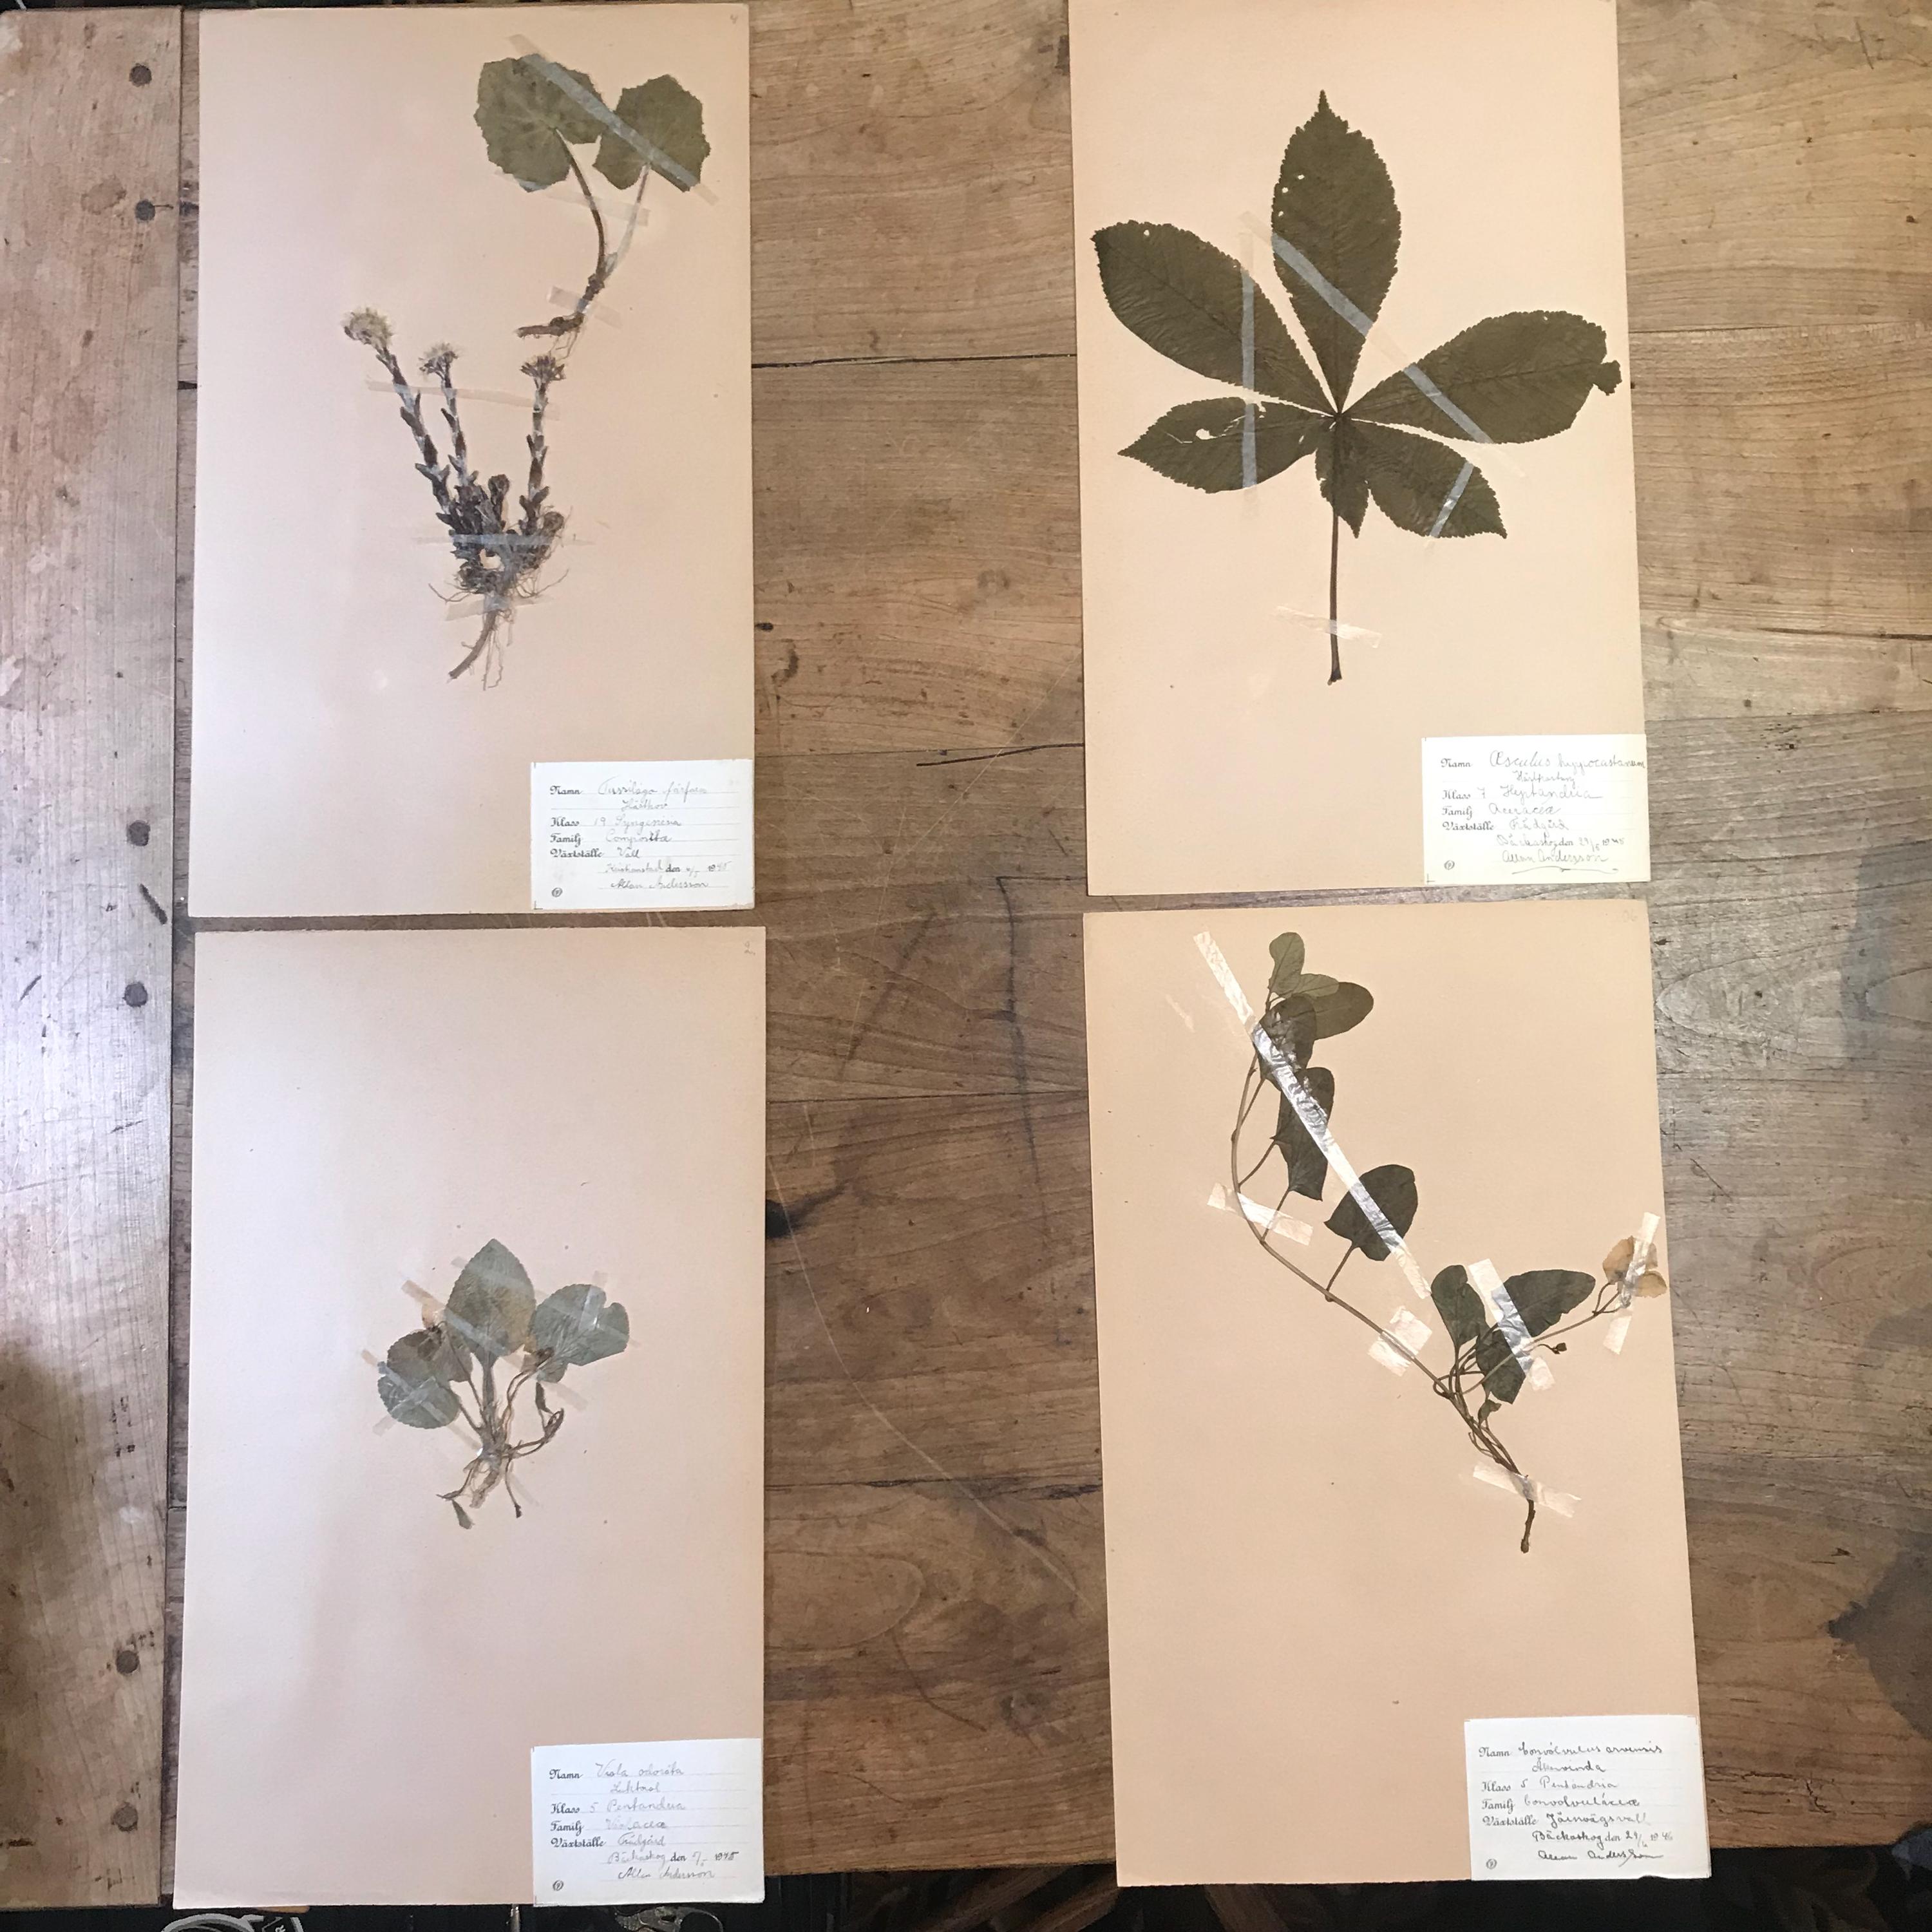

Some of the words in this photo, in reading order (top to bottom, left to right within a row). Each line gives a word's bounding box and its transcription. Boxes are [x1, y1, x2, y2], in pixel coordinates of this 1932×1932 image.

[1441, 758, 1472, 768] Namn
[550, 785, 582, 795] Namn
[1443, 790, 1471, 799] Klass
[1442, 806, 1473, 820] Familj
[551, 817, 580, 827] Klass
[1443, 821, 1495, 830] Växtställe
[550, 833, 582, 847] Familj
[1559, 837, 1574, 846] den
[551, 848, 604, 858] Växtställe
[665, 864, 681, 873] den
[1479, 1747, 1510, 1757] Namn
[549, 1769, 583, 1779] Namn
[1482, 1781, 1511, 1792] Klass
[1520, 1779, 1528, 1788] 5
[551, 1803, 580, 1814] Klass
[589, 1802, 599, 1813] 5
[1482, 1799, 1515, 1814] Familj
[1483, 1815, 1540, 1826] Växtställe
[551, 1820, 583, 1835] Familj
[1605, 1832, 1622, 1842] den
[551, 1837, 606, 1848] Växtställe
[670, 1852, 687, 1862] den
